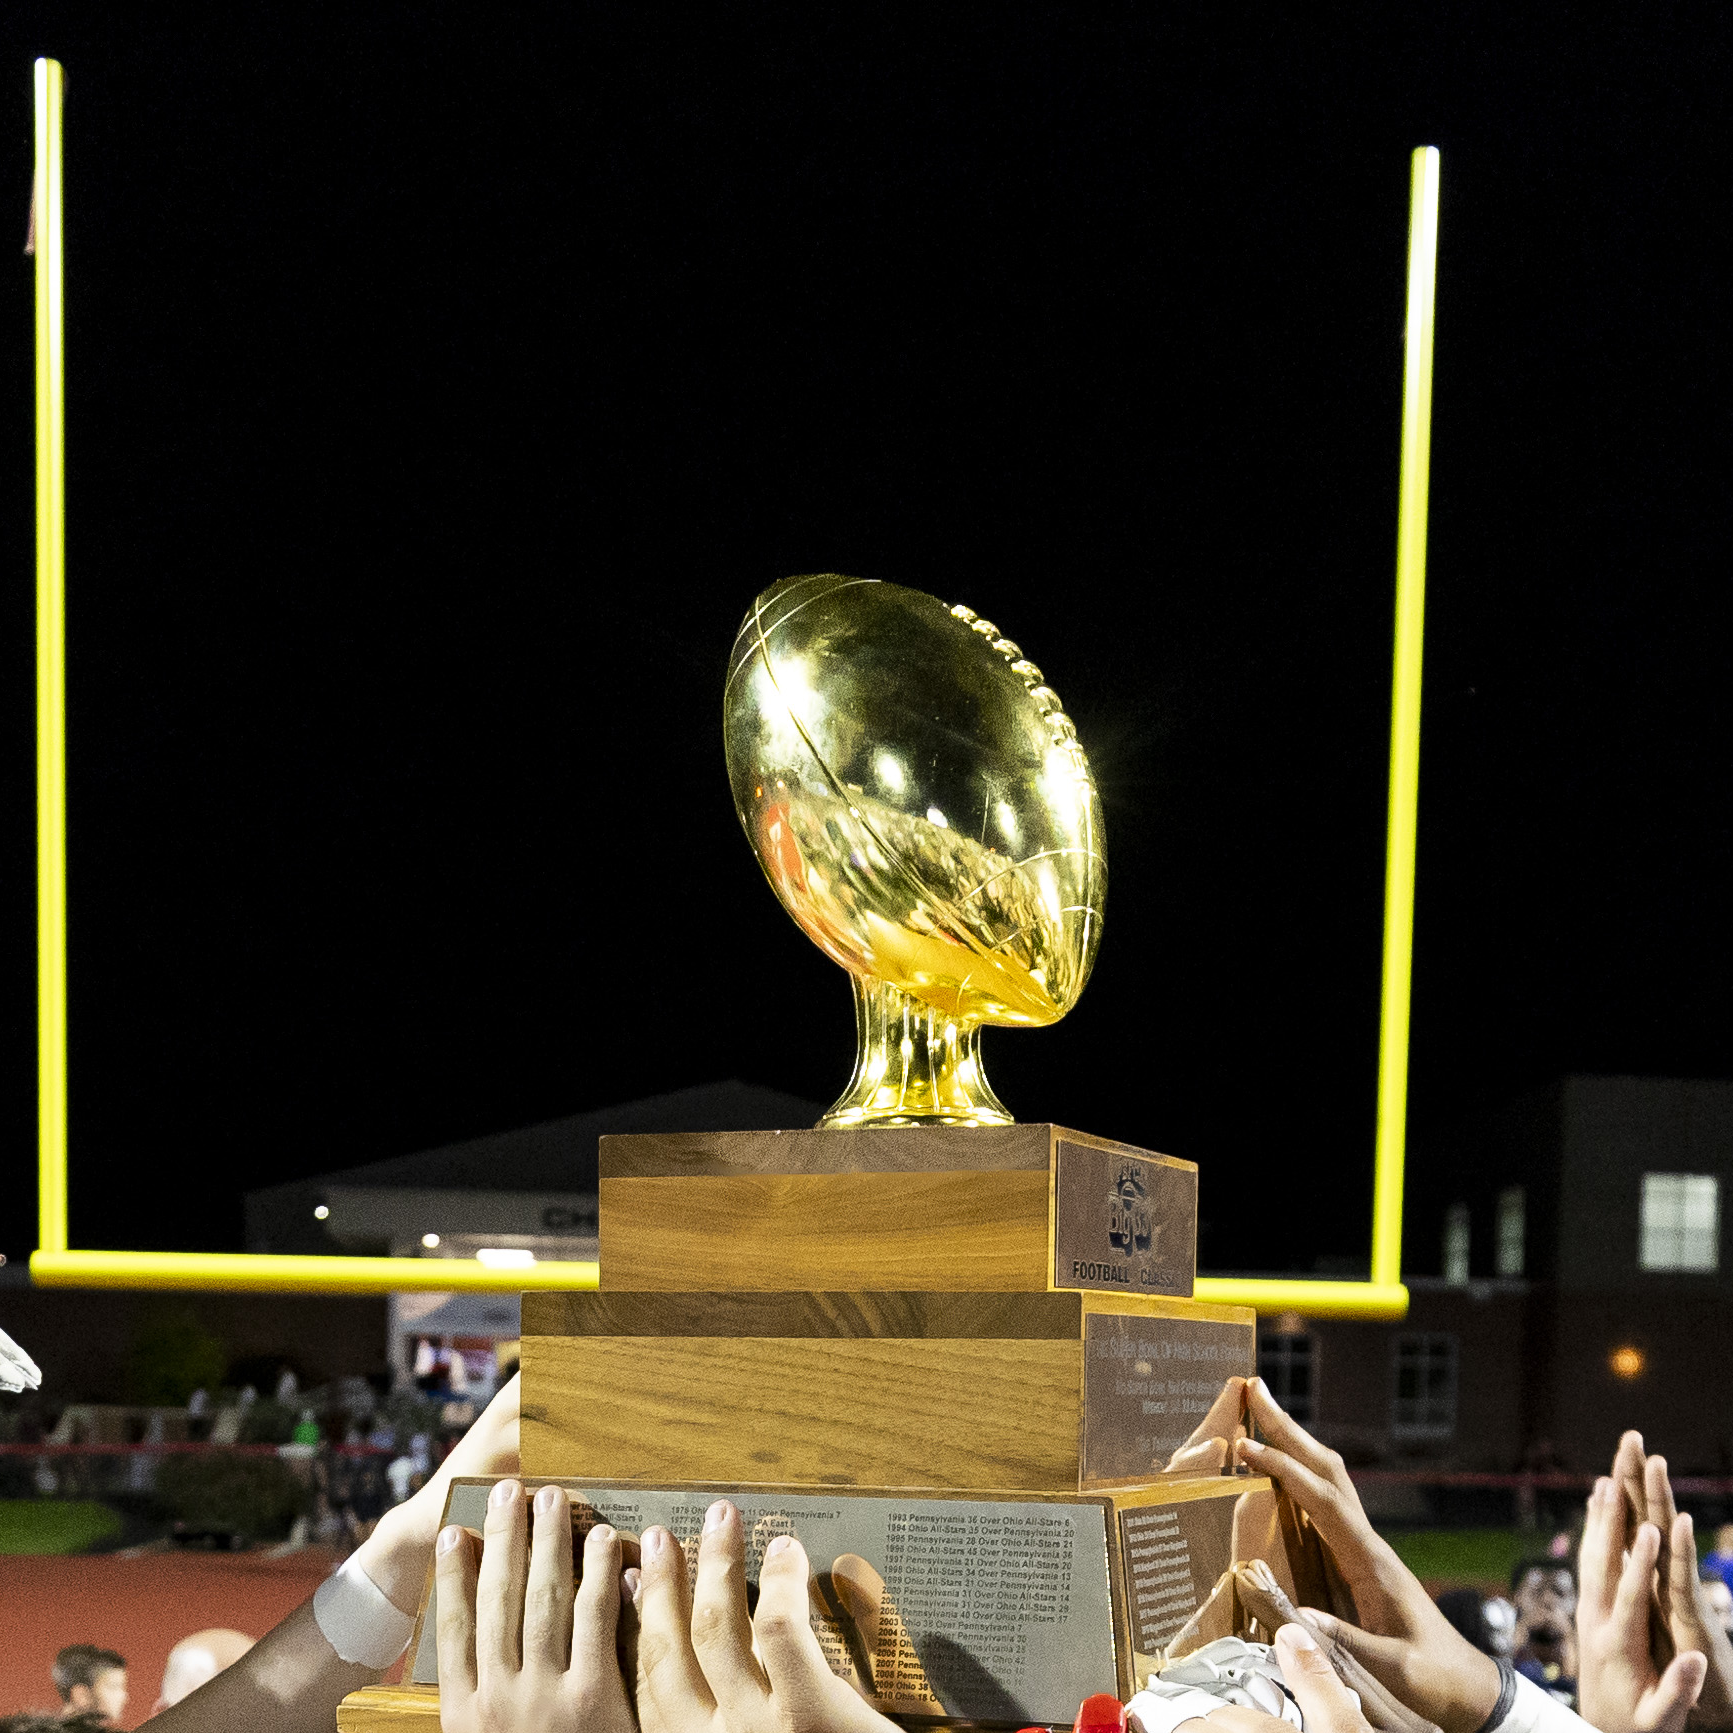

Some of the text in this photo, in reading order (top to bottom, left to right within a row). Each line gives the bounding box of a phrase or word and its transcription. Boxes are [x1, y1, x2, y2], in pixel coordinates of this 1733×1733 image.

[1072, 1260, 1130, 1284] FOOTBALL
[600, 1503, 632, 1511] All-Stars
[691, 1506, 706, 1514] Ohi
[758, 1508, 778, 1516] Over
[780, 1508, 834, 1519] Pennsylvania
[670, 1516, 789, 1528] 1977 PA PA East
[888, 1513, 907, 1522] 1993
[909, 1513, 965, 1525] Pennsylvania
[979, 1515, 1001, 1525] Over
[1002, 1516, 1023, 1526] Ohio
[1025, 1517, 1062, 1527] All-Stars
[689, 1526, 700, 1534] PA
[887, 1523, 906, 1532] 1994
[908, 1523, 928, 1533] Ohio
[930, 1524, 966, 1534] All-Stars
[981, 1526, 1002, 1535] Over
[1004, 1526, 1061, 1538] Pennsylvania
[1063, 1529, 1075, 1538] 20
[688, 1536, 766, 1547] PA PA
[886, 1534, 905, 1542] 1995
[907, 1534, 963, 1546] Pennsylvania
[978, 1537, 998, 1546] Over
[1001, 1538, 1022, 1547] Ohio
[1023, 1538, 1060, 1548] All-Stars
[1063, 1540, 1073, 1549] 21
[907, 1545, 927, 1554] Ohio
[929, 1546, 965, 1555] All-Stars
[979, 1547, 1000, 1557] Over
[1002, 1548, 1060, 1560] Pennsylvania
[687, 1557, 697, 1565] PA
[885, 1555, 1072, 1570] 1997 Pennsylvania 21 Over Ohio All-Stars 20
[884, 1565, 903, 1574] 1998
[905, 1565, 925, 1575] Ohio
[927, 1566, 963, 1576] All-Stars
[978, 1569, 998, 1578] Over
[1000, 1569, 1058, 1581] Pennsylvania
[1061, 1571, 1071, 1581] 13
[883, 1576, 902, 1585] 1999
[904, 1576, 924, 1586] Ohio
[926, 1577, 962, 1587] All-Stars
[977, 1579, 998, 1588] Over
[999, 1580, 1057, 1592] Pennsylvania
[1060, 1582, 1070, 1591] 14
[882, 1586, 901, 1595] 2000
[903, 1586, 959, 1598] Pennsylvania
[974, 1590, 995, 1599] Over
[997, 1590, 1017, 1600] Ohio
[1019, 1591, 1056, 1601] All-Stars
[881, 1596, 899, 1605] 2001
[903, 1597, 958, 1608] Pennsylvania
[973, 1600, 994, 1610] Over
[996, 1601, 1017, 1611] Ohio
[1018, 1602, 1055, 1612] All-Stars
[879, 1607, 899, 1616] 2002
[902, 1607, 958, 1619] Pennsylvania
[973, 1611, 994, 1620] Over
[995, 1612, 1016, 1621] Ohio
[1018, 1613, 1055, 1623] All-Stars
[1058, 1615, 1068, 1624] 17
[879, 1617, 898, 1626] 2003
[901, 1618, 921, 1628] Ohio
[935, 1620, 956, 1629] Over
[958, 1621, 1015, 1632] Pennsylvania
[878, 1627, 897, 1636] 2004
[900, 1628, 920, 1638] Ohio
[934, 1631, 955, 1640] Over
[957, 1631, 1014, 1642] Pennsylvania
[878, 1638, 897, 1647] 2005
[877, 1649, 896, 1658] 2006
[992, 1654, 1013, 1664] Ohio
[875, 1670, 894, 1679] 2008
[876, 1659, 895, 1668] 2007
[992, 1665, 1012, 1675] Ohio
[896, 1681, 916, 1691] Ohio
[895, 1691, 915, 1701] Ohio
